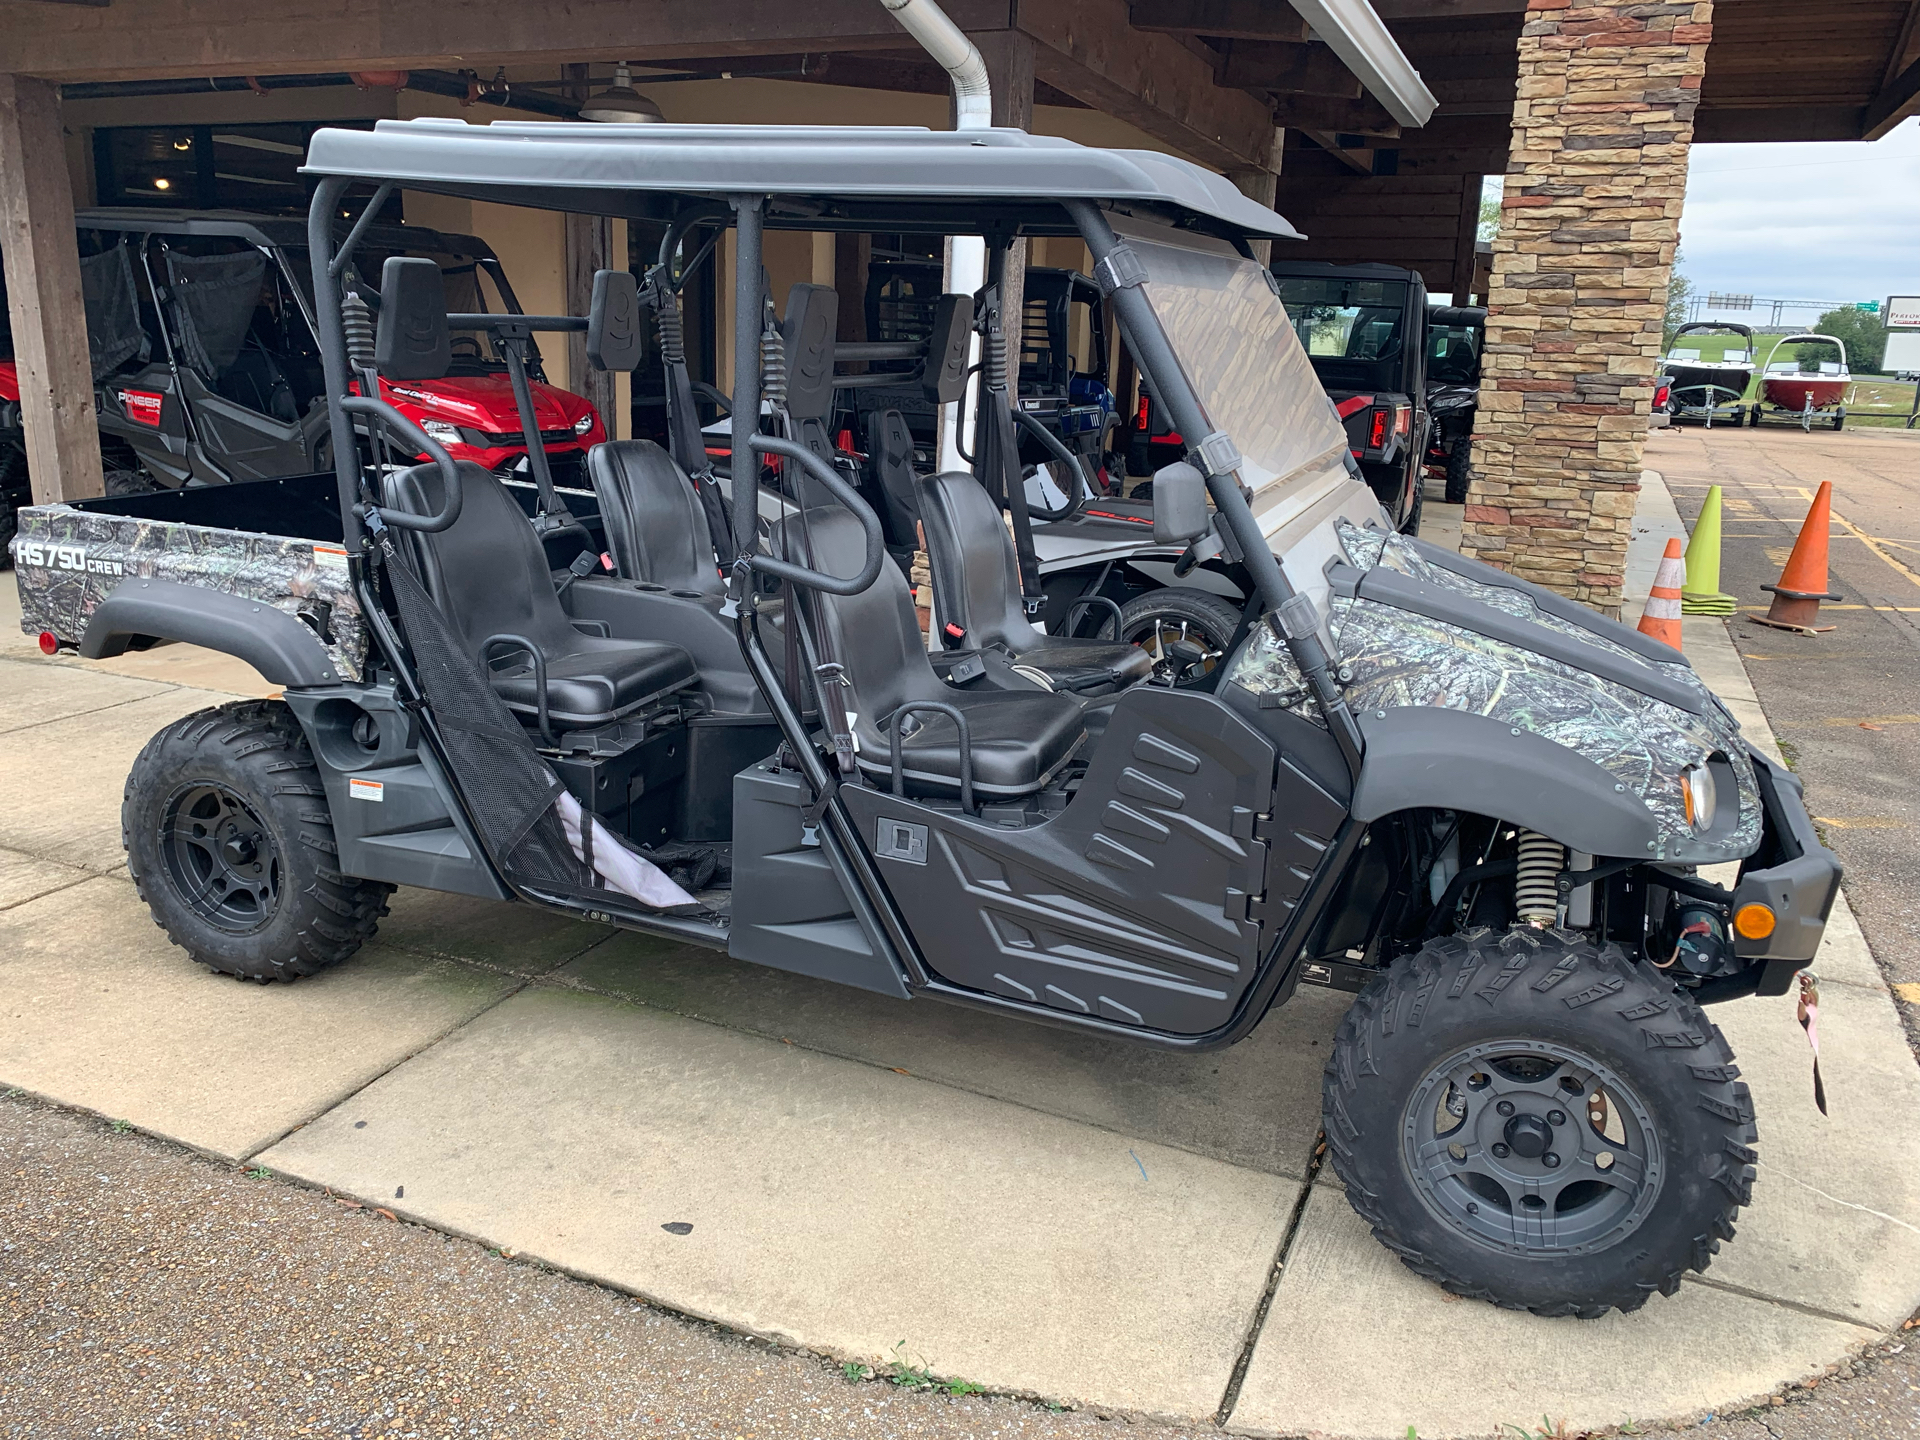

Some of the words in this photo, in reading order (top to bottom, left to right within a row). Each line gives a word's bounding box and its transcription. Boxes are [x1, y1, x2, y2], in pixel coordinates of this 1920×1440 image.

[118, 391, 161, 409] PIONEER
[859, 388, 938, 412] Kawasa
[16, 541, 86, 571] HS750
[86, 559, 122, 576] CREW
